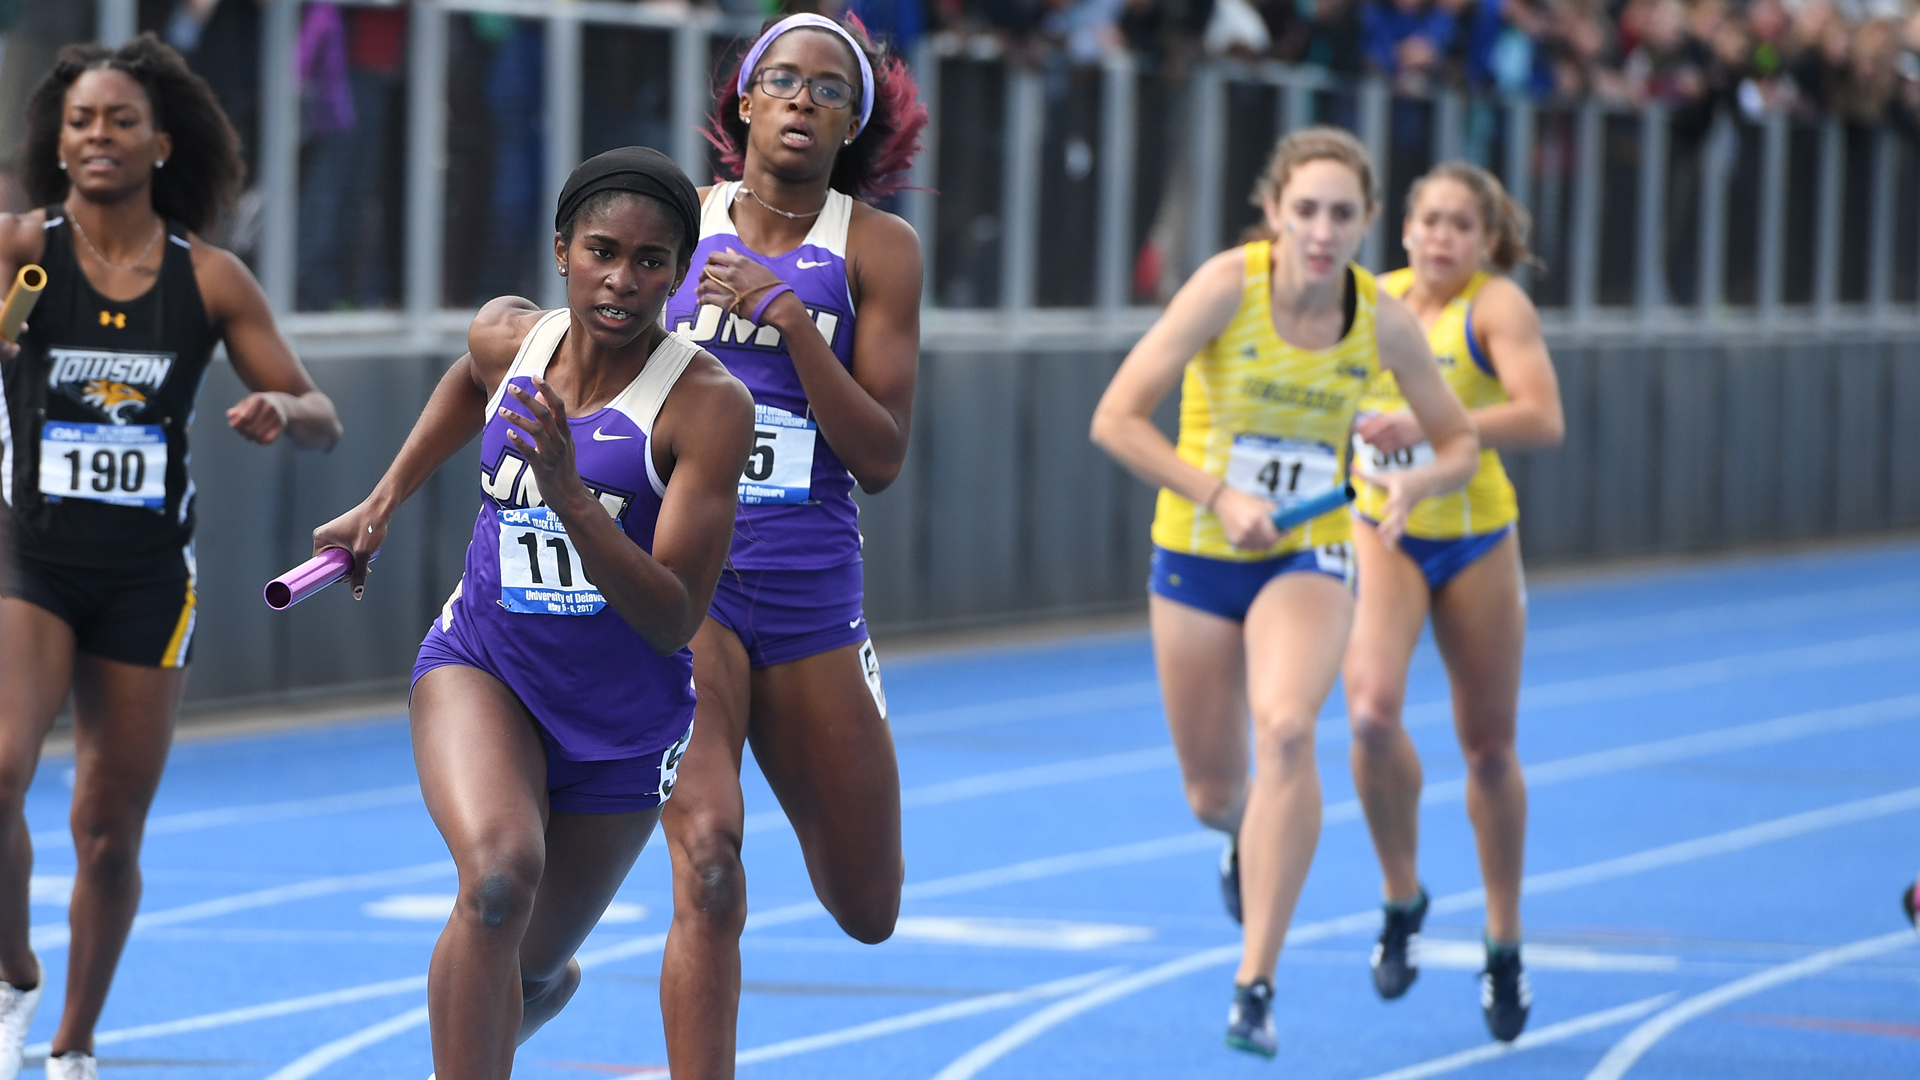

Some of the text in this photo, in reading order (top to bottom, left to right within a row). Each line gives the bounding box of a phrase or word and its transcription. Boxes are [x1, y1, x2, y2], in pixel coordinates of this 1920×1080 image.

[49, 349, 175, 389] TOWSON
[64, 449, 145, 492] 190
[1257, 460, 1303, 492] 41
[746, 485, 785, 498] Delaware
[503, 510, 531, 524] CAA
[532, 518, 566, 532] TRACK & FIE
[518, 532, 597, 587] 11
[526, 590, 564, 603] University
[565, 593, 573, 603] of
[548, 603, 561, 612] May
[578, 604, 593, 612] 2017
